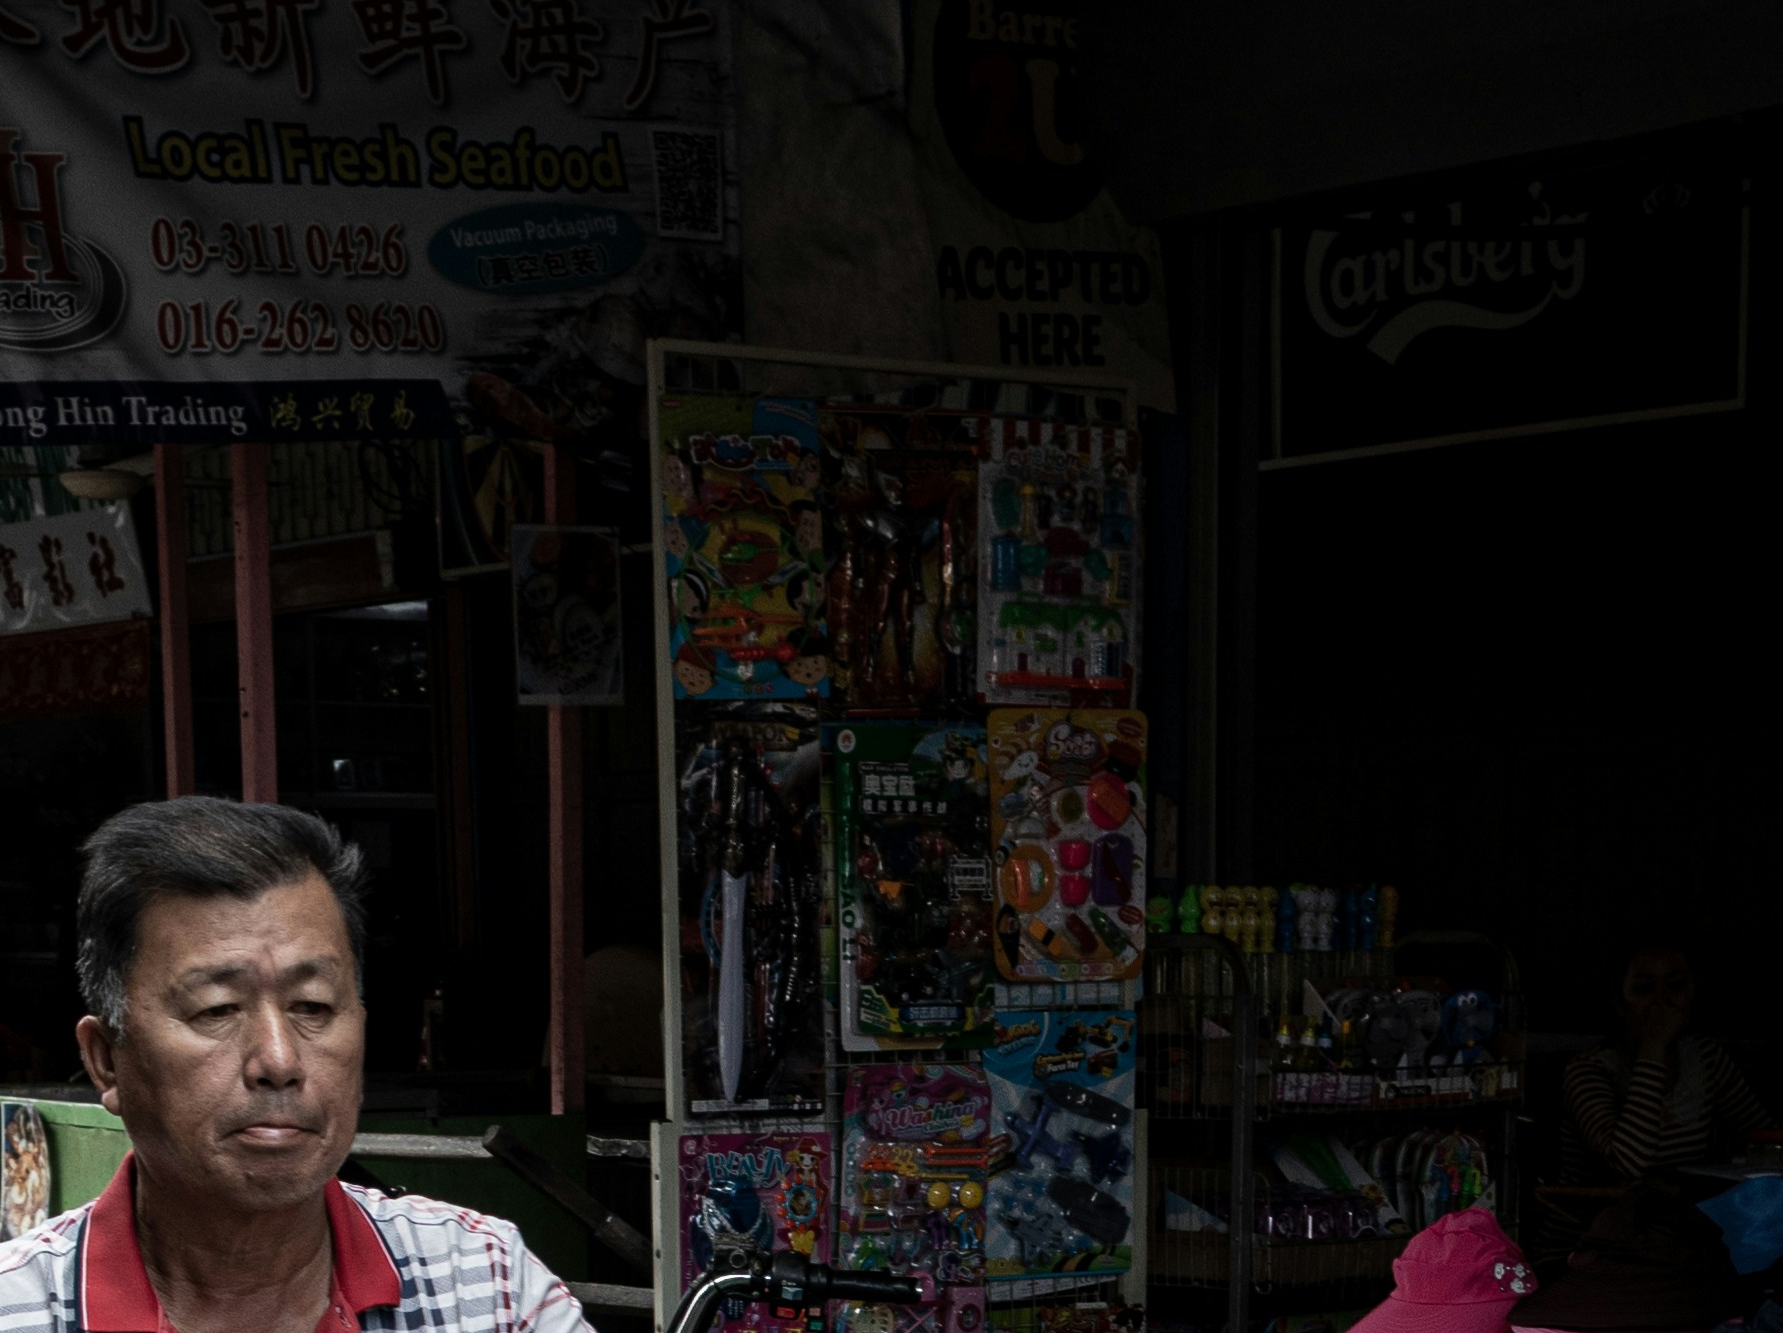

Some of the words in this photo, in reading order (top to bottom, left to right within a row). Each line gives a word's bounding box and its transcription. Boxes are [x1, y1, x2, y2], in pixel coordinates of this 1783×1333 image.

[124, 116, 269, 184] Local
[278, 120, 418, 188] Fresh
[427, 128, 628, 194] Seafood
[152, 218, 295, 275] 03-311
[306, 219, 407, 276] 0426
[450, 222, 521, 249] Vacuum
[523, 210, 619, 241] Packaging
[476, 242, 609, 286] (真空包装)
[938, 246, 1150, 305] ACCEPTED
[157, 301, 336, 355] 016-262
[348, 302, 445, 354] 8620
[1000, 313, 1106, 366] HERE
[56, 398, 118, 429] Hin
[123, 396, 249, 435] Trading
